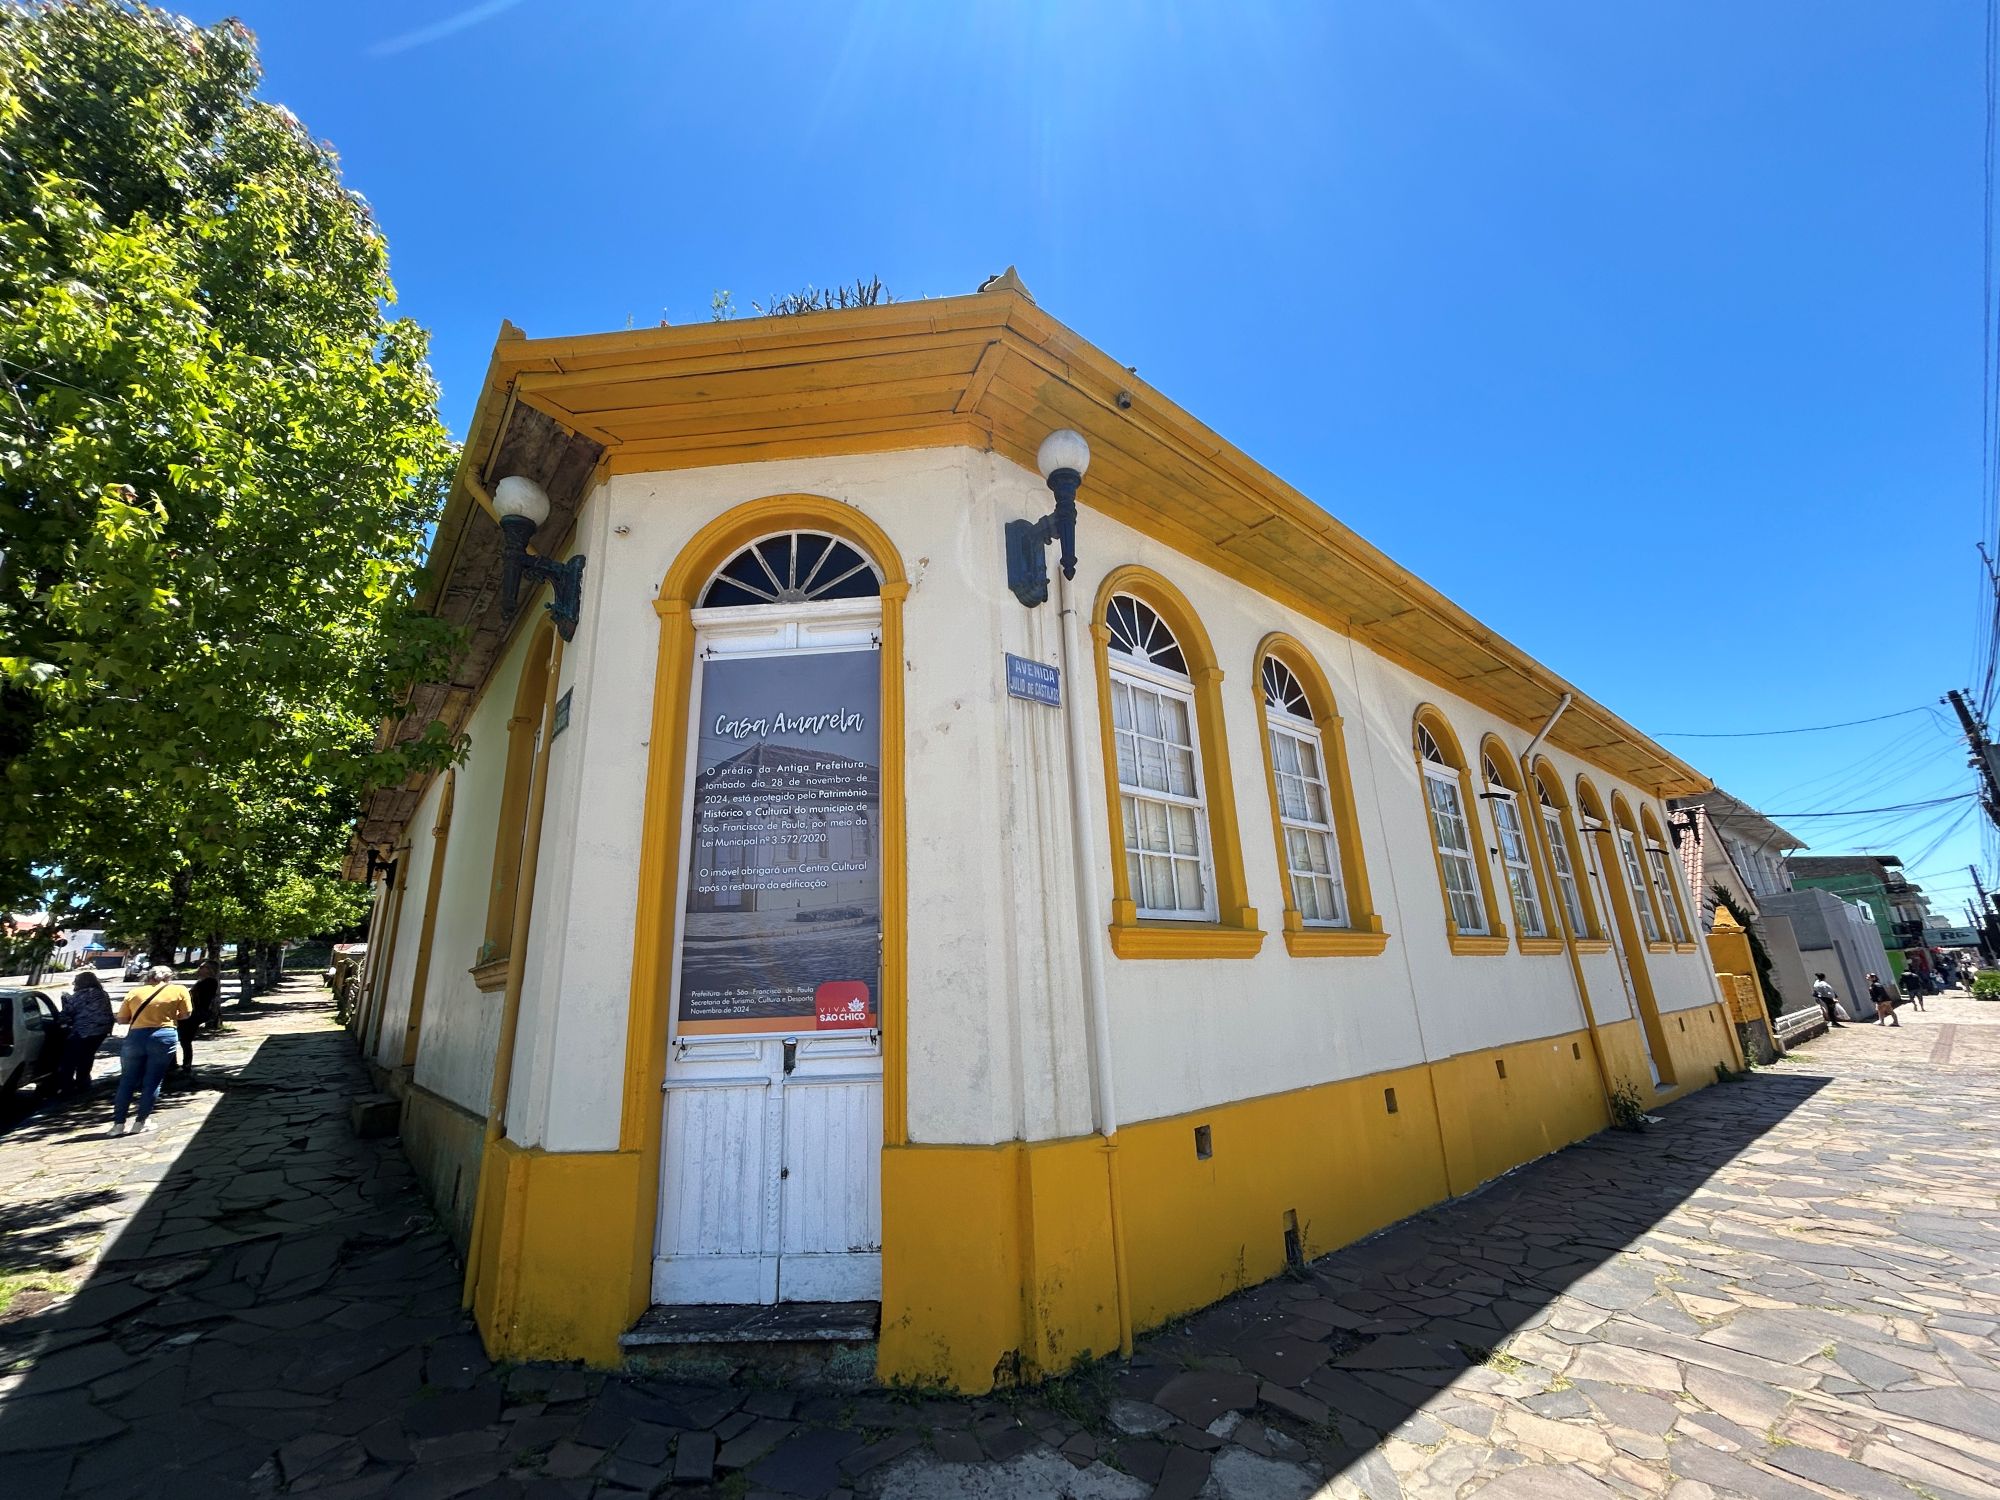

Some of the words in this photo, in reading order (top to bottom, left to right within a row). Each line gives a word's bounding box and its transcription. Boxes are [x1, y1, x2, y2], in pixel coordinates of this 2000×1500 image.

[1015, 660, 1055, 684] AVENIDA
[1027, 682, 1034, 695] DE
[715, 713, 769, 739] Casa
[773, 707, 865, 735] Amarela
[706, 767, 716, 776] O
[721, 766, 753, 777] prédio
[758, 765, 771, 774] da
[776, 763, 809, 774] Antiga
[816, 760, 868, 771] Prefeitura,
[705, 780, 746, 790] tombado
[751, 779, 766, 788] dia
[771, 778, 783, 787] 28
[788, 777, 800, 786] de
[806, 775, 851, 785] novembro
[856, 773, 868, 782] de
[704, 795, 730, 804] 2024,
[732, 794, 751, 803] está
[753, 792, 795, 803] protegido
[797, 790, 817, 801] pelo
[818, 788, 868, 799] Patrimônio
[703, 808, 743, 818] Histórico
[755, 806, 791, 816] Cultural
[794, 805, 806, 814] do
[809, 803, 854, 814] município
[856, 802, 868, 811] de
[702, 824, 719, 833] São
[722, 822, 764, 832] Francisco
[767, 822, 778, 830] de
[781, 820, 808, 829] Paula,
[812, 821, 827, 830] por
[830, 818, 852, 827] meio
[855, 817, 867, 825] da
[701, 839, 714, 848] Lei
[715, 836, 758, 847] Municipal
[771, 833, 829, 845] 3.572/2020.
[700, 868, 708, 877] O
[710, 867, 740, 877] imóvel
[741, 865, 780, 877] abrigará
[799, 863, 830, 873] Centro
[831, 861, 867, 871] Cultural
[698, 882, 720, 894] após
[729, 881, 765, 891] restauro
[766, 880, 779, 890] da
[780, 879, 829, 890] edificação.
[691, 990, 720, 998] Prefeitura
[736, 988, 749, 996] São
[752, 987, 781, 995] Francisco
[731, 997, 757, 1005] Turismo,
[690, 1006, 722, 1015] Novembro
[733, 1005, 750, 1013] 2024
[820, 1013, 838, 1022] SÃO
[839, 1012, 866, 1021] CHICO
